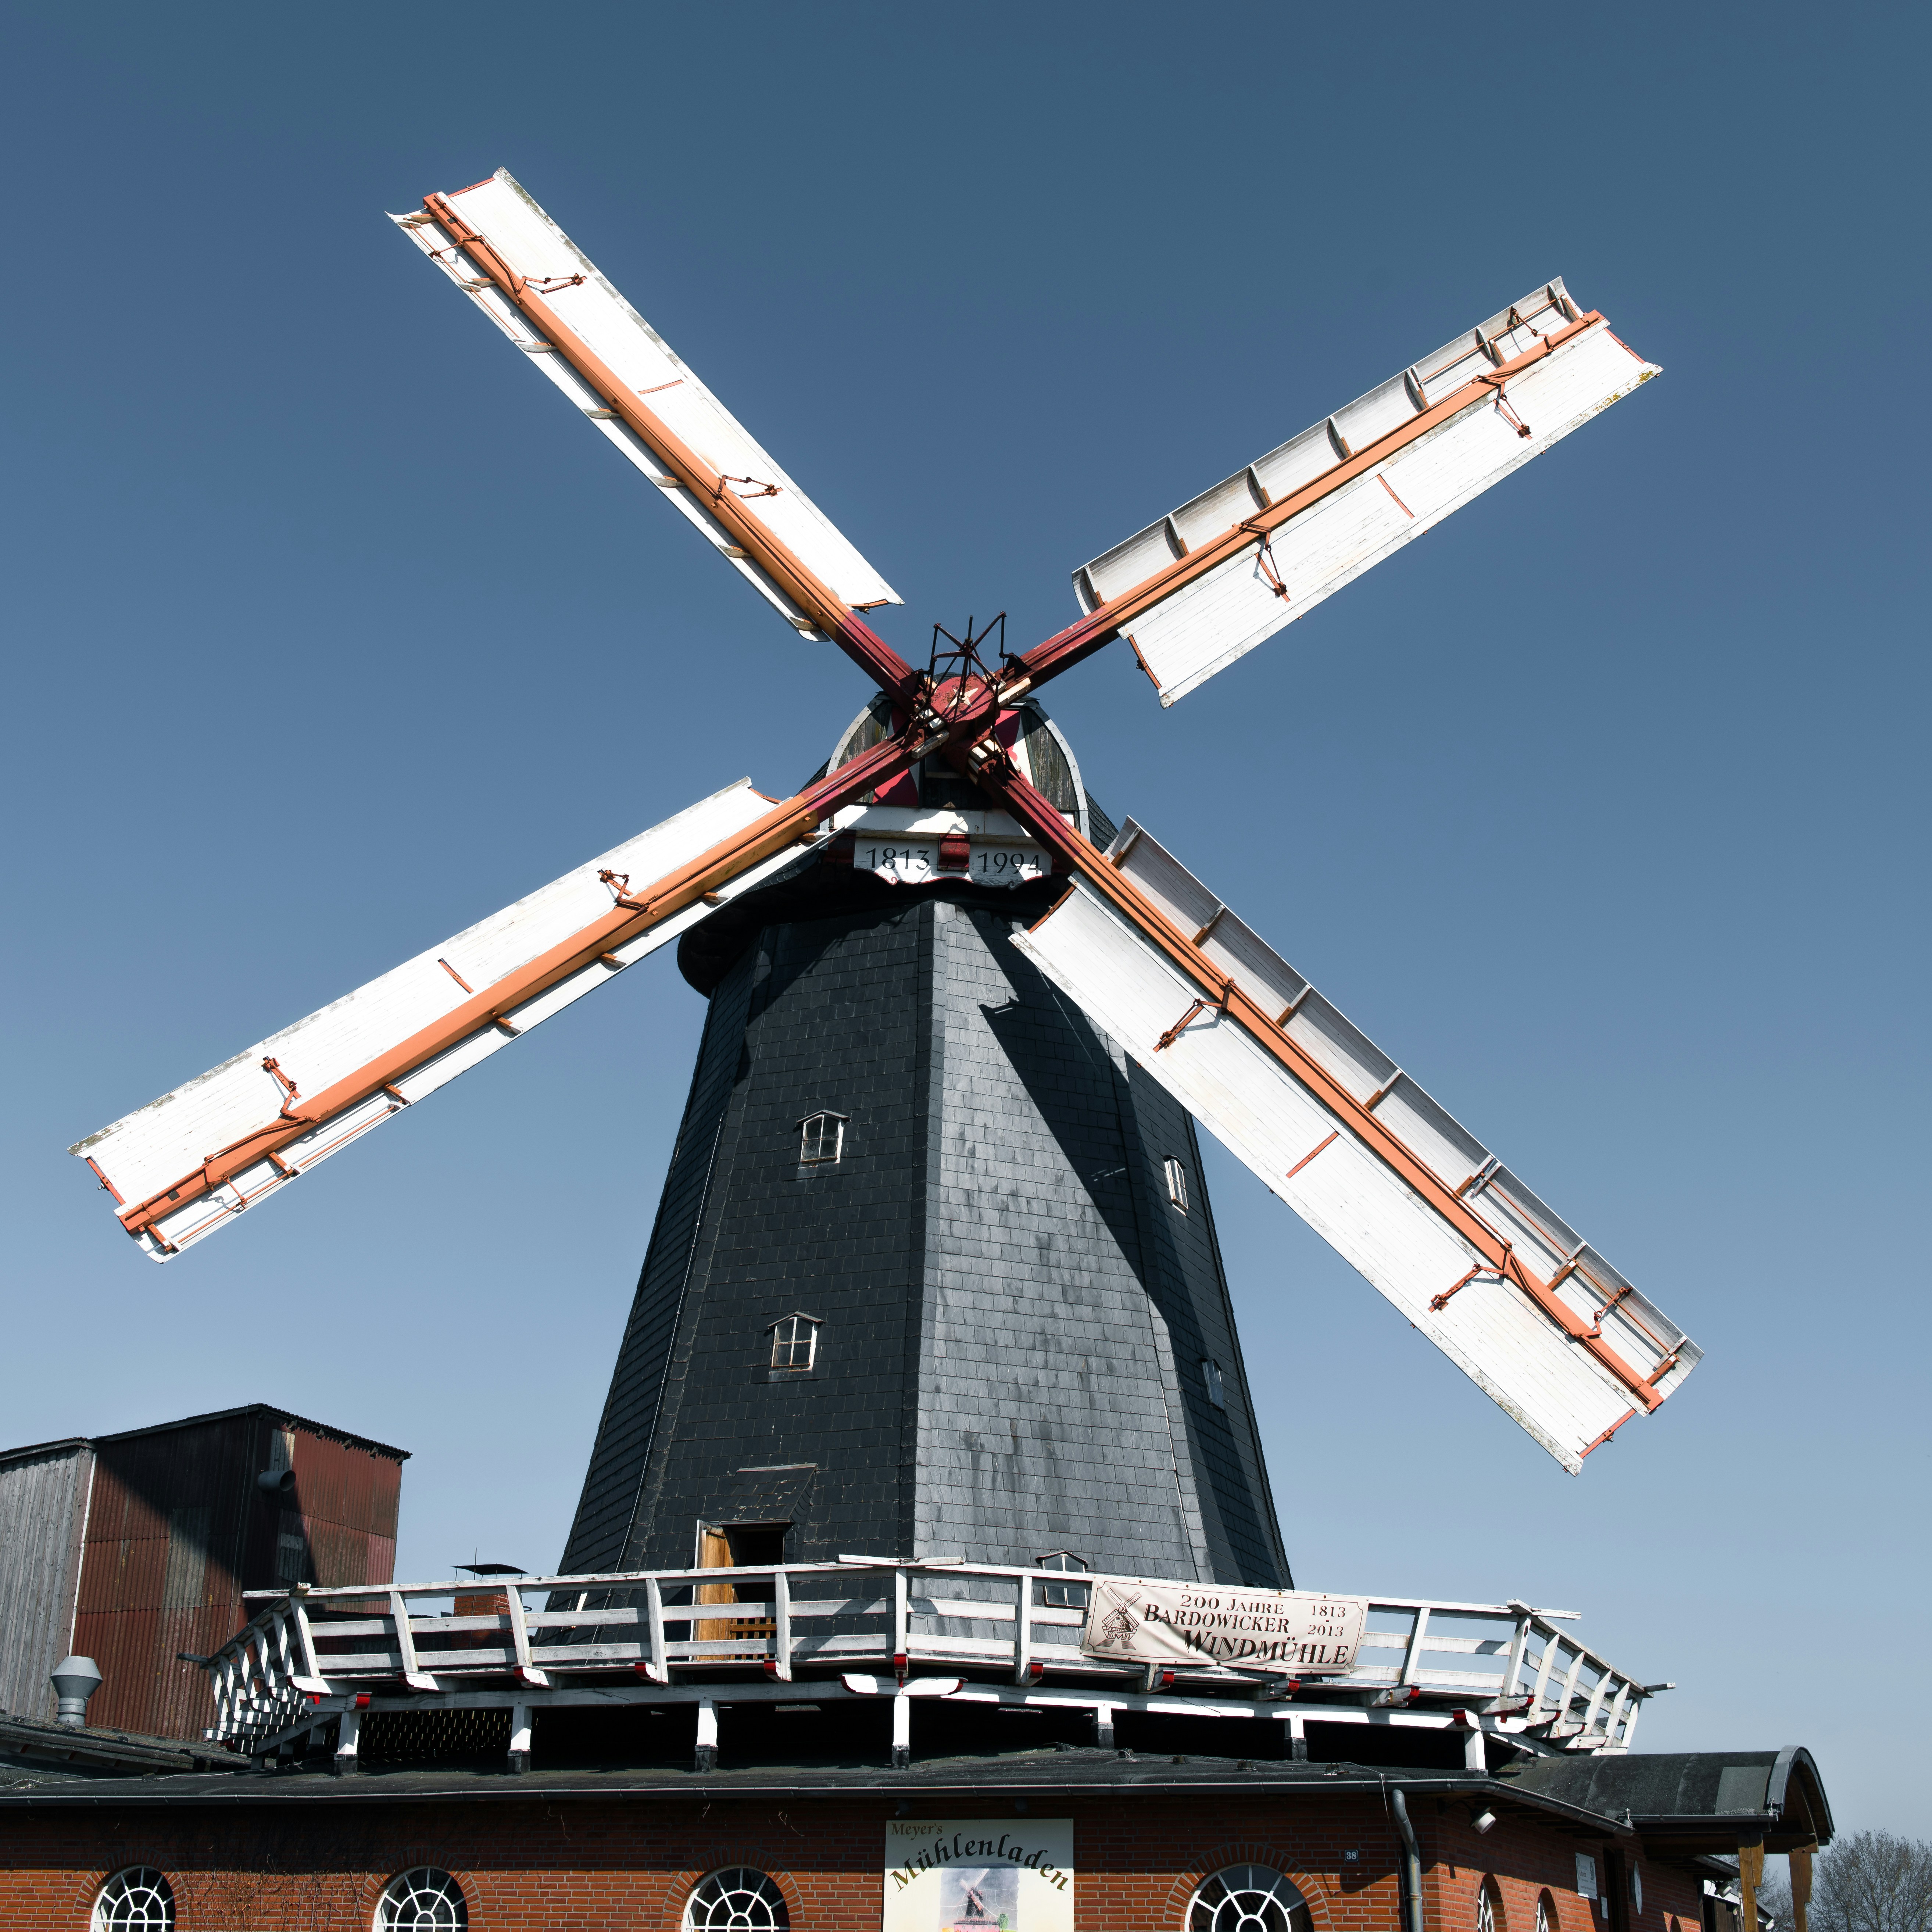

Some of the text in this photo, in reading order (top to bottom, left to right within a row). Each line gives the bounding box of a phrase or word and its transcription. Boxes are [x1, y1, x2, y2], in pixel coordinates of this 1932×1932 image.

[866, 848, 930, 870] 1813
[978, 852, 1041, 874] 1994
[1180, 1595, 1284, 1614] 200 JAHRE
[1312, 1605, 1345, 1618] 1813
[1144, 1604, 1289, 1633] BARDOWICKER
[1308, 1624, 1344, 1637] 2013
[1184, 1629, 1349, 1664] WINDMÜHLE
[890, 1833, 1068, 1892] Mühlenladen
[1346, 1852, 1357, 1860] 38
